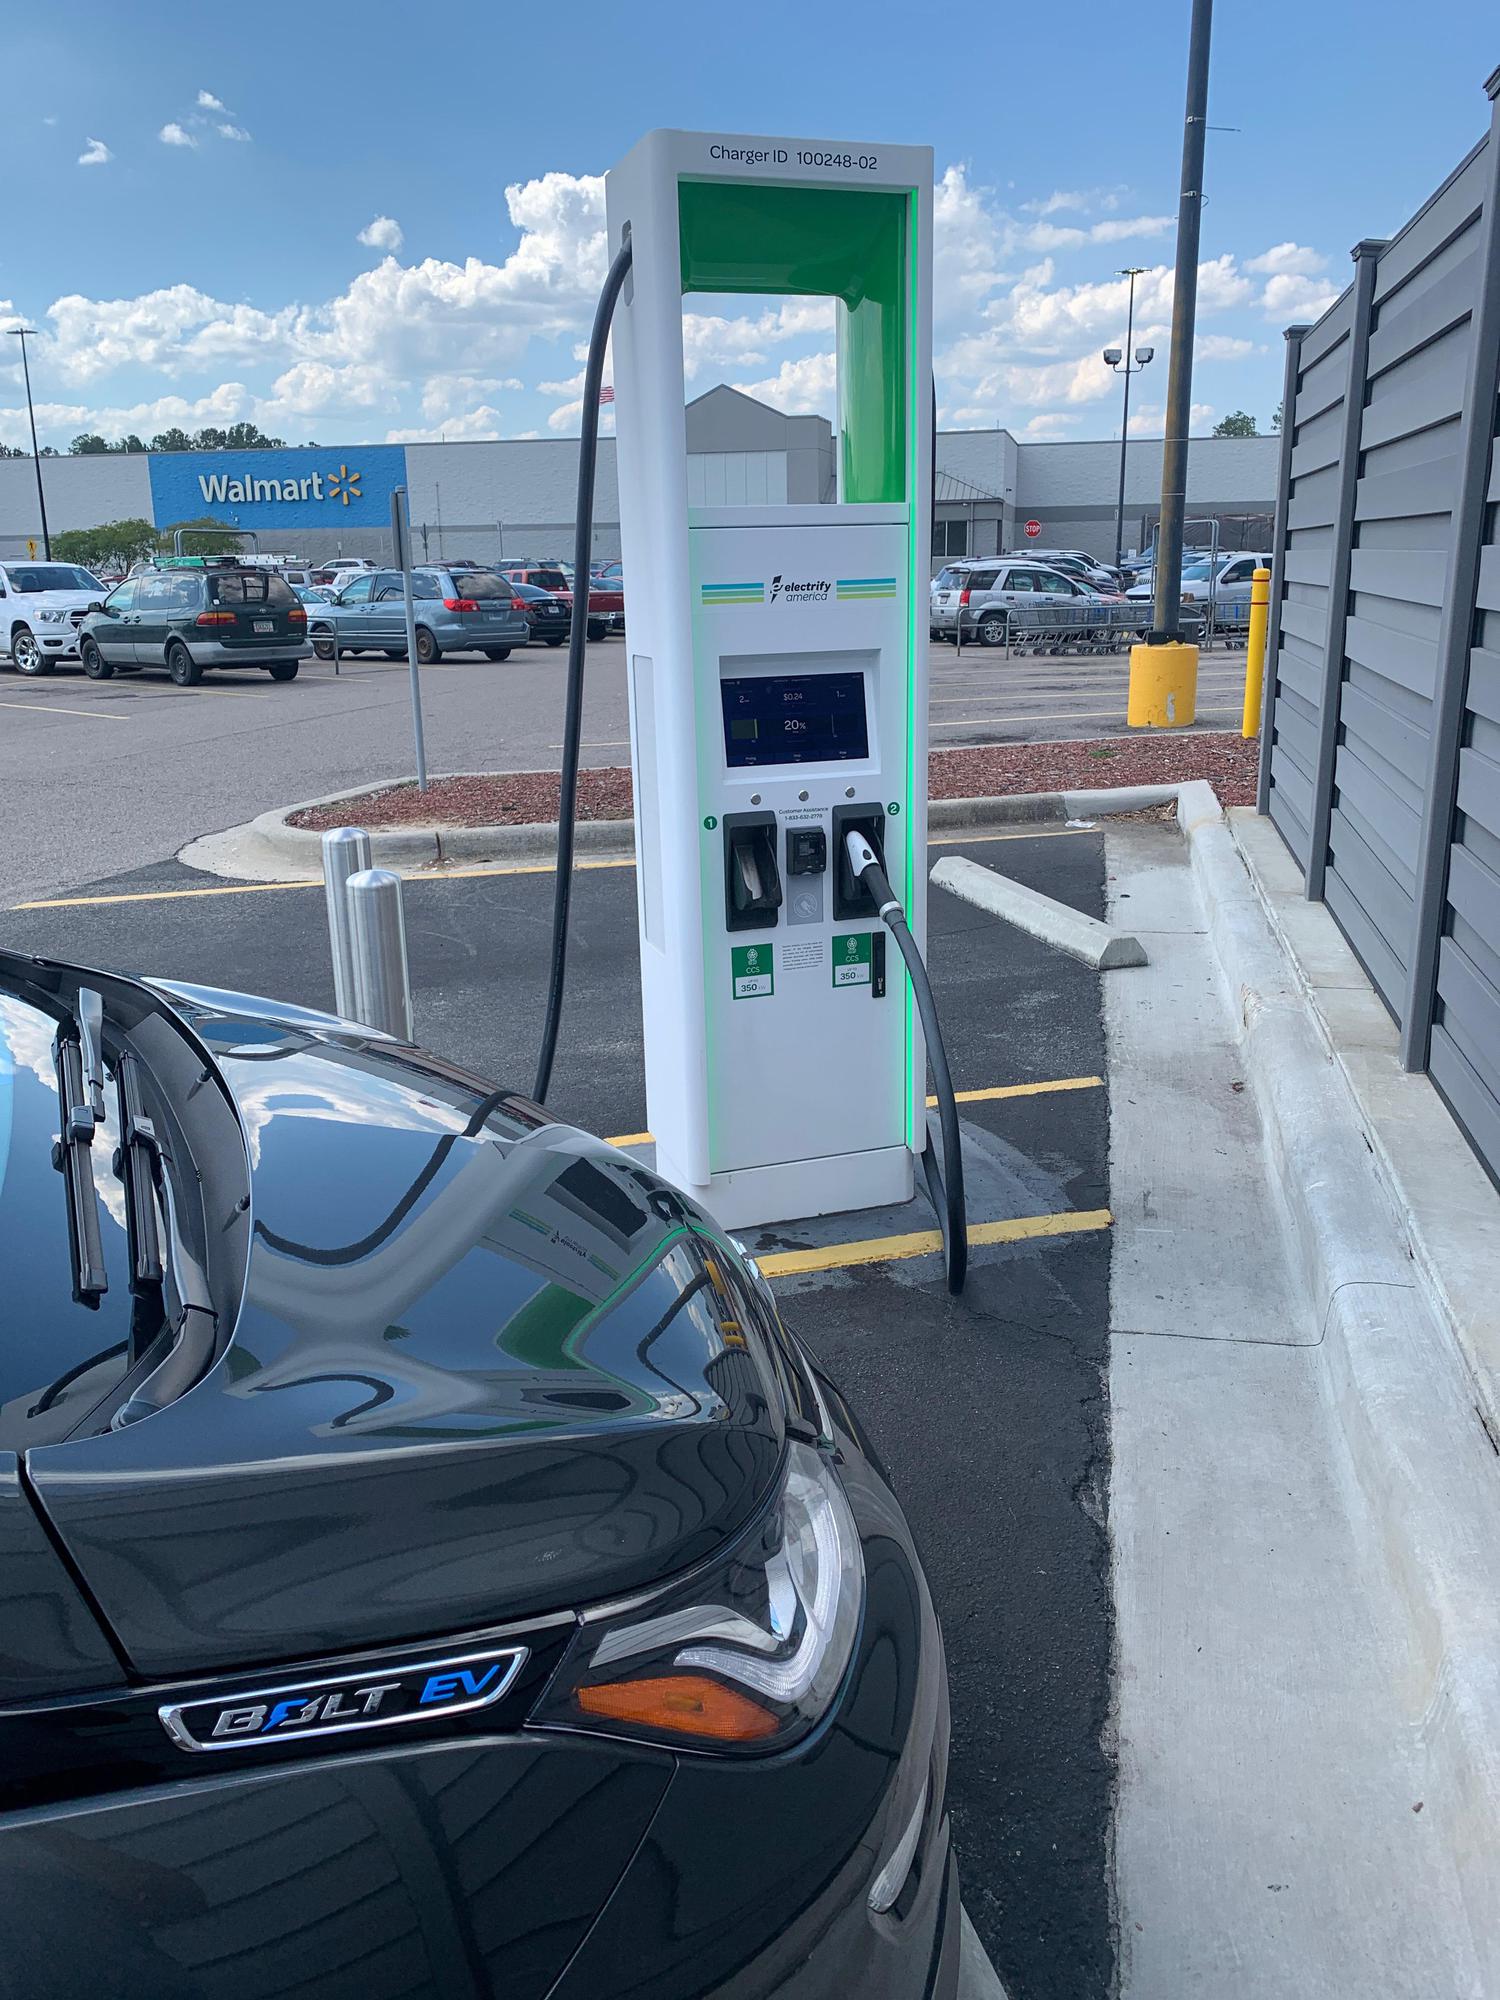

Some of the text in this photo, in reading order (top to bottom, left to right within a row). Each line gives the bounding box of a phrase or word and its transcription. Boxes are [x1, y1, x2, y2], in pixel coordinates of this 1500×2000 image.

[709, 144, 878, 170] Charger ID 100248-02
[198, 471, 324, 503] Walmart
[1025, 525, 1040, 533] STOP
[784, 580, 831, 592] electrify
[785, 591, 828, 601] america
[783, 692, 803, 701] $0.24
[784, 719, 807, 731] 20%
[890, 803, 898, 814] 2
[846, 954, 860, 963] CCS
[745, 966, 760, 974] CCS
[840, 971, 856, 981] 350
[740, 983, 757, 992] 350
[211, 1664, 501, 1737] BOLT EV
